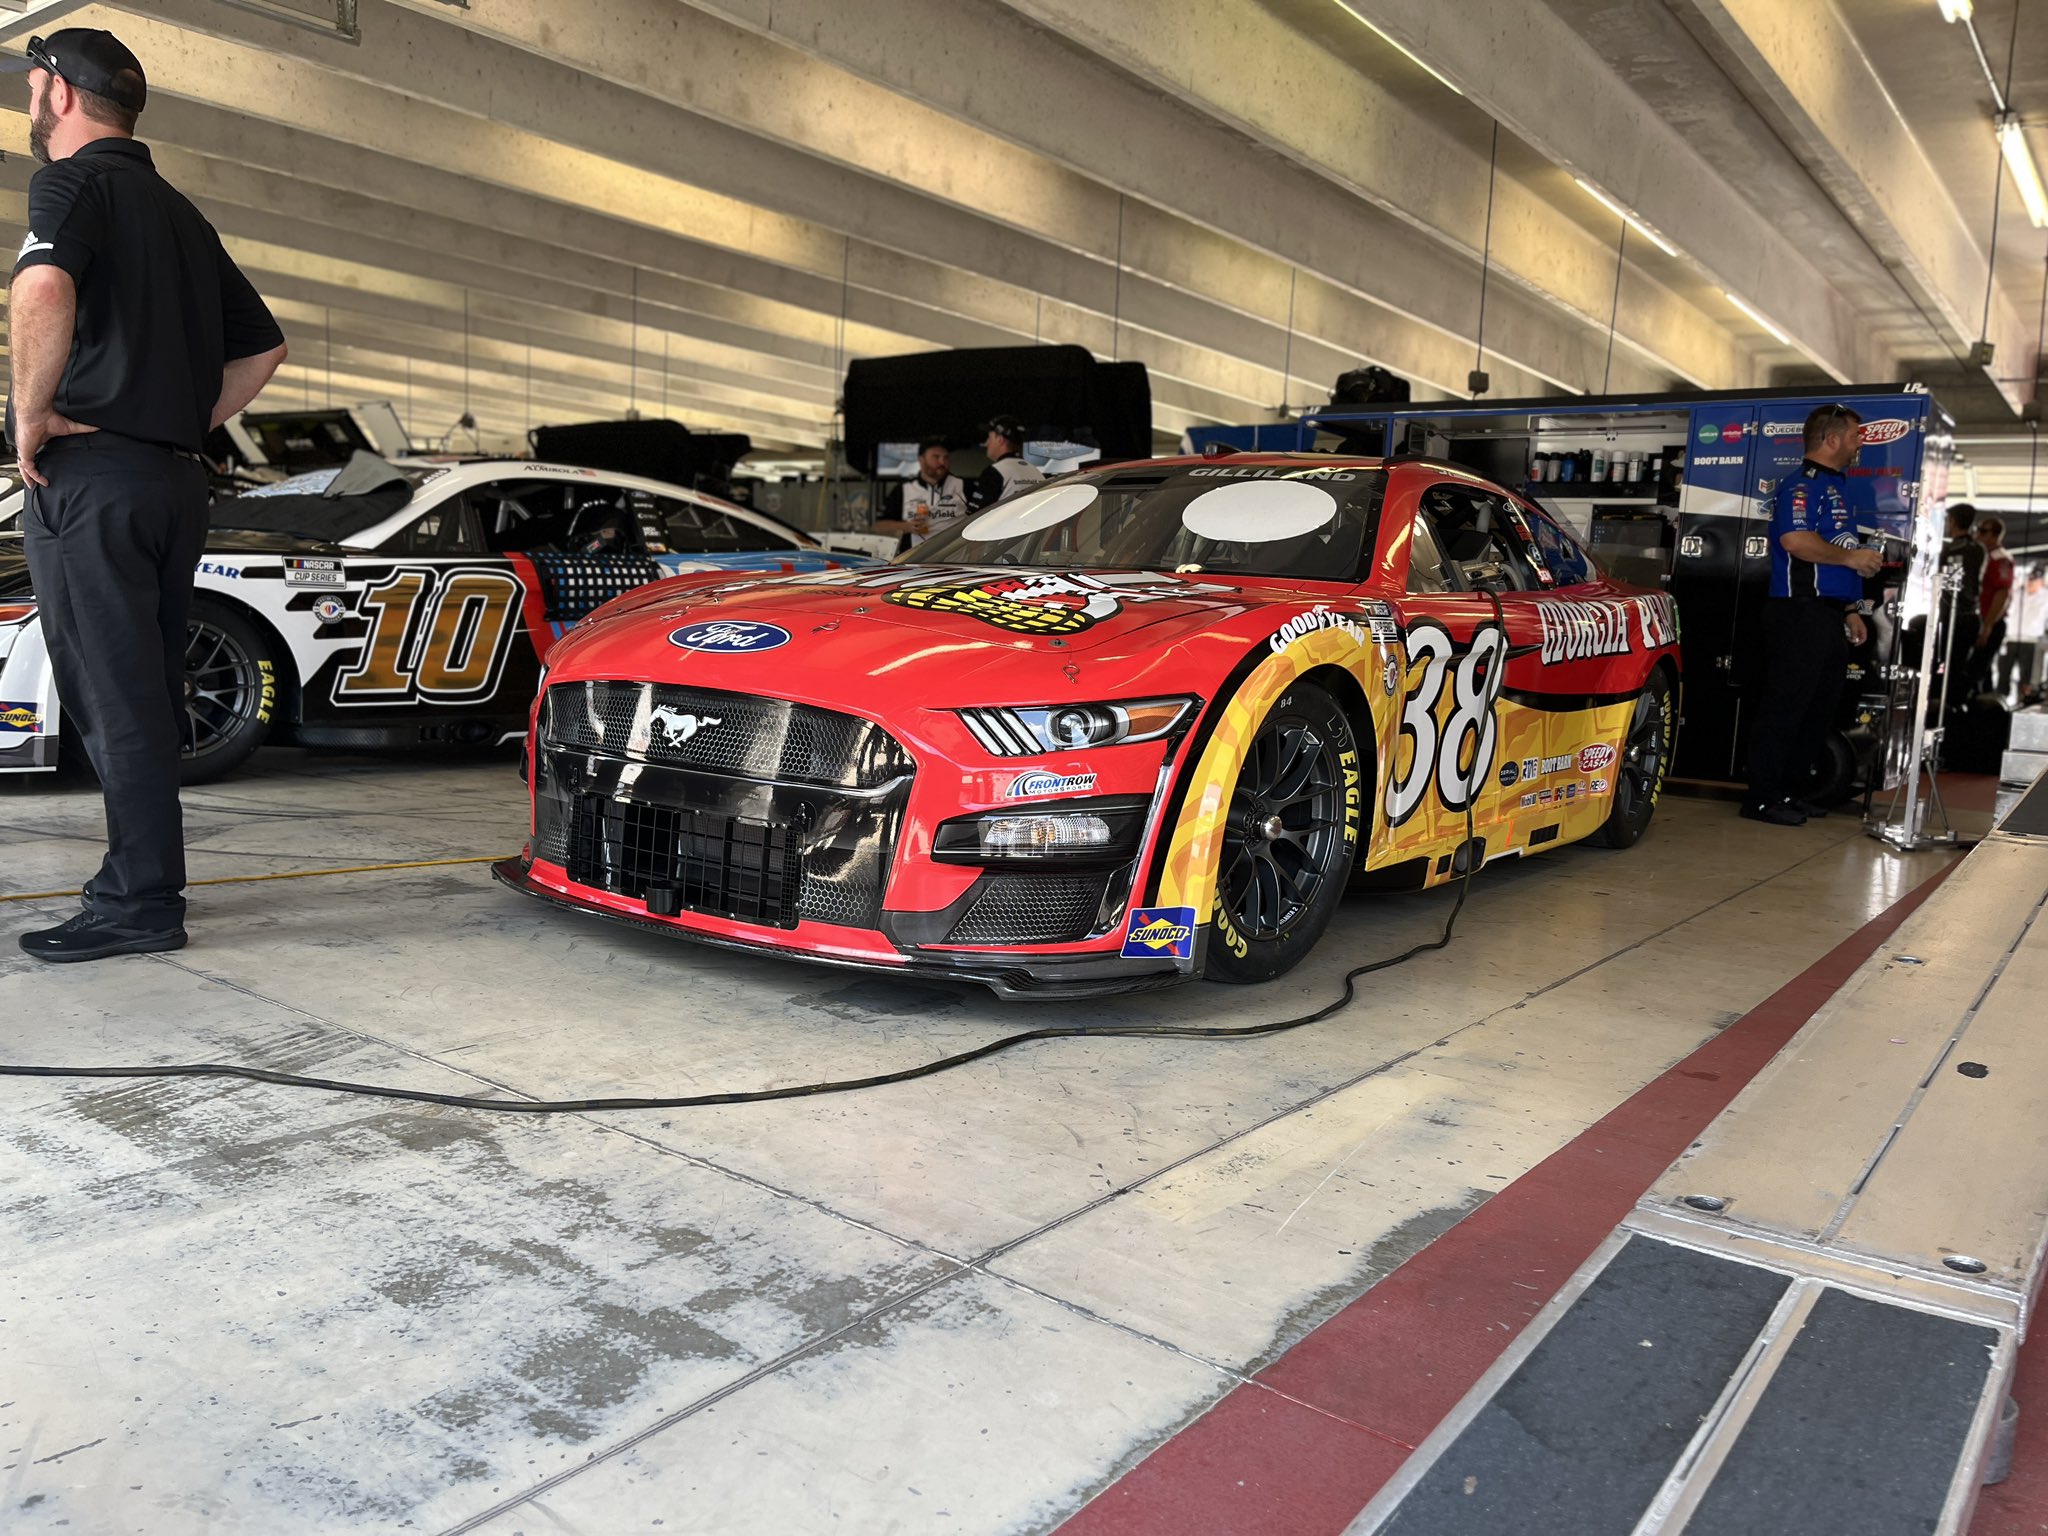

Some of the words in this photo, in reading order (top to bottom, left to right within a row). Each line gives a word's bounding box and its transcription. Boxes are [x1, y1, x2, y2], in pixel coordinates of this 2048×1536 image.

[1865, 422, 1905, 435] SPEEDY
[1866, 431, 1901, 441] CASH
[1694, 457, 1718, 465] BOOT
[1719, 456, 1745, 465] BARN
[523, 463, 581, 475] ALMIROLA
[1189, 468, 1356, 481] GILLILAND
[303, 560, 335, 570] NASCAR
[294, 571, 311, 581] CUP
[311, 573, 337, 583] SERIES
[330, 565, 527, 706] 10
[686, 623, 770, 648] Ford
[1270, 607, 1366, 655] GOODYEAR
[1536, 600, 1630, 665] GEORGIA
[256, 660, 275, 724] EAGLE
[1281, 696, 1293, 709] 84
[1384, 620, 1508, 825] 38
[1583, 746, 1613, 761] SPEEDY
[1583, 758, 1609, 770] CASH
[1029, 785, 1093, 794] MOTORSPORTS
[1339, 750, 1361, 845] EAGLE
[1130, 927, 1188, 941] SUNOCO
